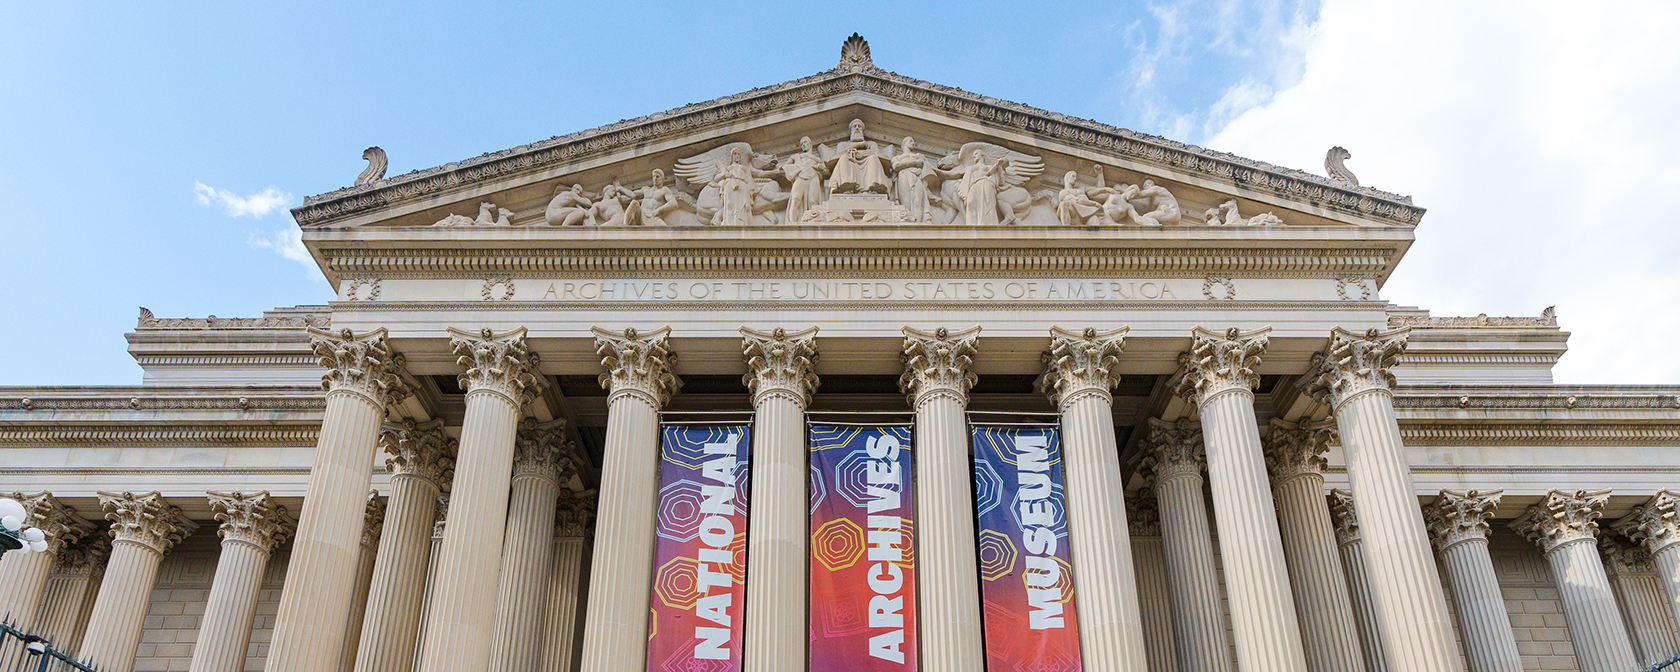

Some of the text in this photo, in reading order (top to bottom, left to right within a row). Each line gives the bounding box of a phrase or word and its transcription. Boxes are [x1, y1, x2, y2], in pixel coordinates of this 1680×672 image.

[542, 282, 1177, 299] ARCHIVES OF THE UNITED STATES OF AMERICA
[694, 433, 738, 660] NATIONAL
[866, 434, 905, 665] ARCHIVES
[1015, 435, 1065, 630] MUSEUM
